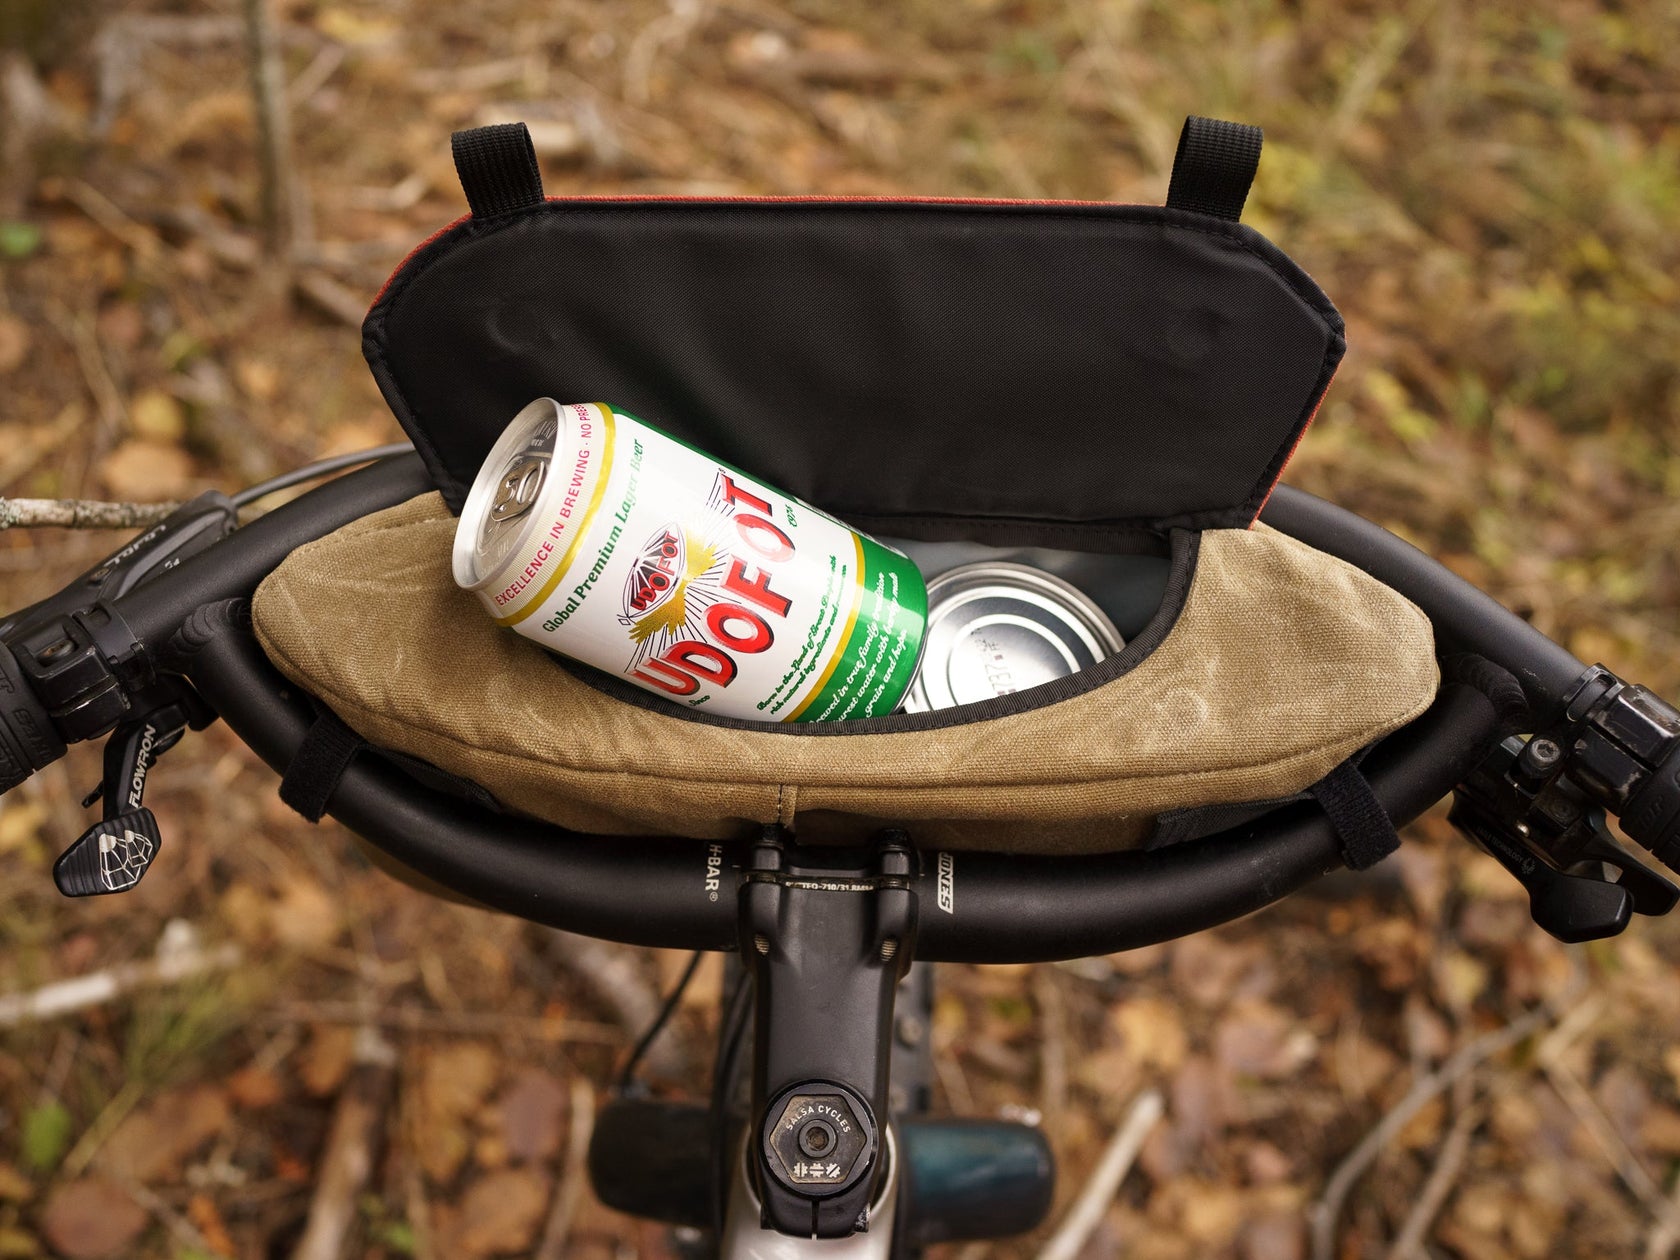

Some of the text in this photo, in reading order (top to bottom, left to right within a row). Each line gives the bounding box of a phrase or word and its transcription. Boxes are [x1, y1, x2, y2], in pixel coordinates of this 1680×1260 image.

[495, 541, 554, 606] EXCELLENCE
[549, 521, 565, 540] IN
[560, 449, 590, 519] BREWING
[581, 423, 592, 439] NO
[542, 439, 644, 632] Global Premium Lager Beer
[757, 692, 777, 711] Born
[770, 701, 784, 714] rich
[782, 672, 806, 706] natural
[805, 628, 832, 675] ingredients
[809, 693, 841, 724] rewed
[838, 684, 849, 698] in
[847, 661, 864, 684] true
[857, 619, 880, 667] family
[838, 696, 859, 723] urest
[857, 663, 878, 698] water
[875, 633, 889, 664] with
[864, 683, 886, 719] grain
[882, 656, 897, 684] and
[939, 852, 952, 911] JONES
[786, 1105, 851, 1133] SALSA CYCLES
